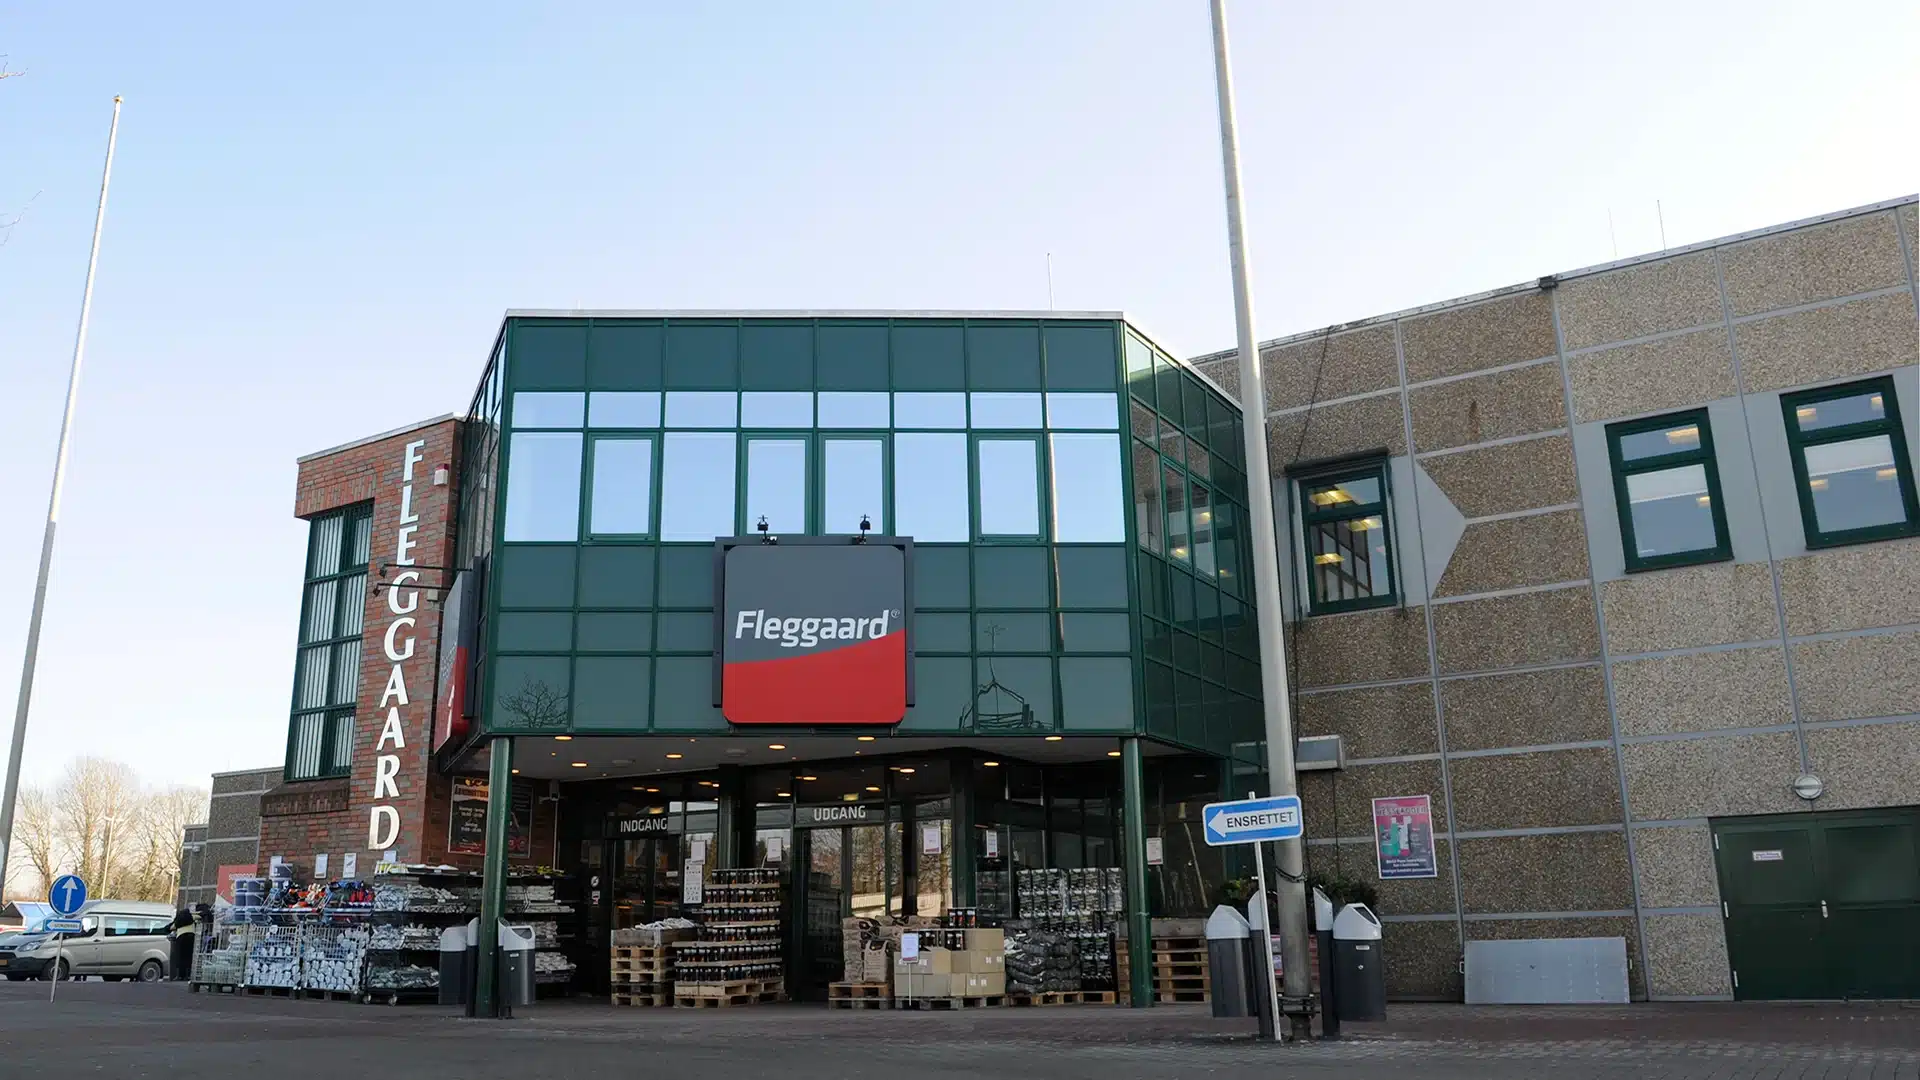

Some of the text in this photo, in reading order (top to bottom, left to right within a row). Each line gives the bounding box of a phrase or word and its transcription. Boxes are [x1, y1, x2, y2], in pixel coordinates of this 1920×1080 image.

[735, 609, 889, 648] Fleggaard
[368, 439, 425, 851] FLEGGAARD
[813, 805, 866, 821] UDGANG
[1226, 811, 1294, 828] ENSRETTET
[620, 817, 668, 833] INDGANG
